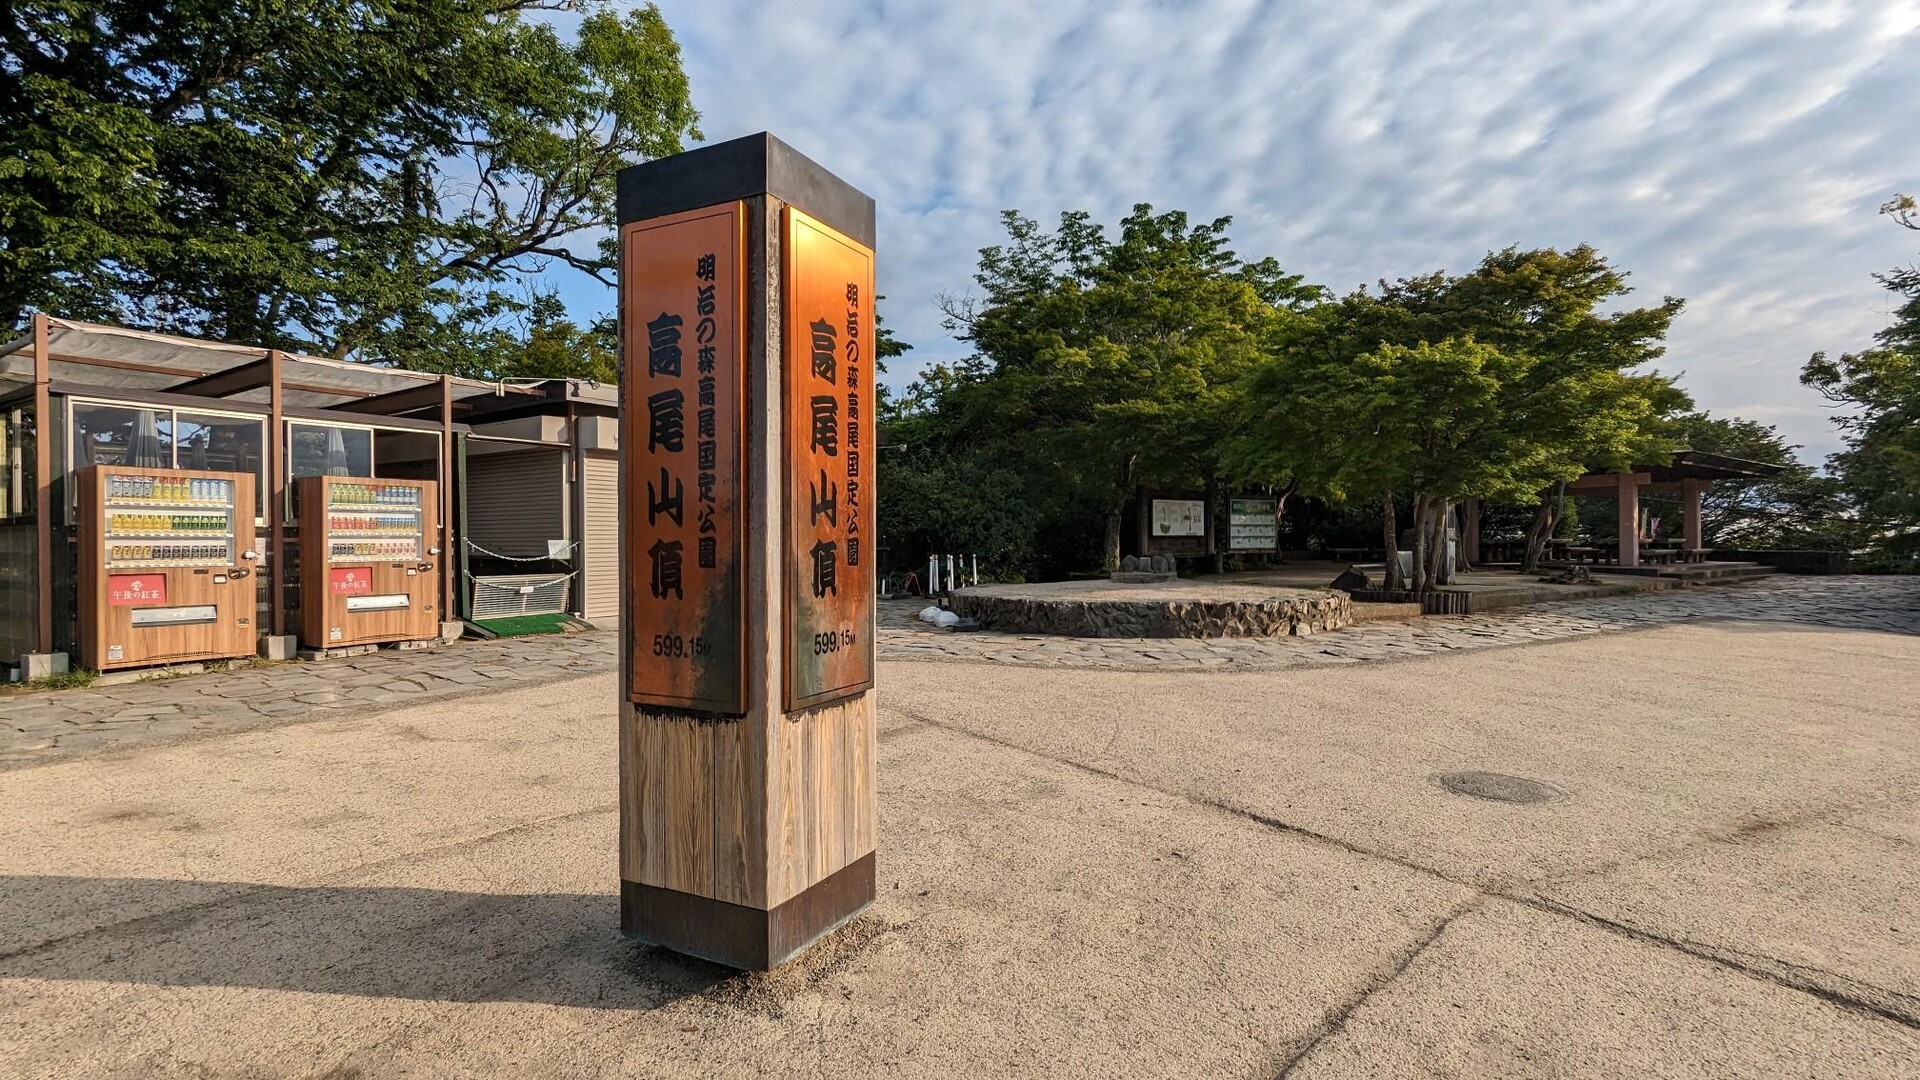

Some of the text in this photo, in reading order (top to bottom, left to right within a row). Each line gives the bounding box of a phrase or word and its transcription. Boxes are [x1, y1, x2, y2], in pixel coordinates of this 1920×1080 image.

[646, 311, 685, 601] 高尾山頂
[695, 252, 717, 569] 明治の森高尾国定公園
[809, 317, 838, 599] 高尾山頂
[845, 282, 859, 567] 明治の森高尾国定公園
[113, 589, 160, 600] 午後の紅茶
[333, 580, 368, 590] 午後の紅茶
